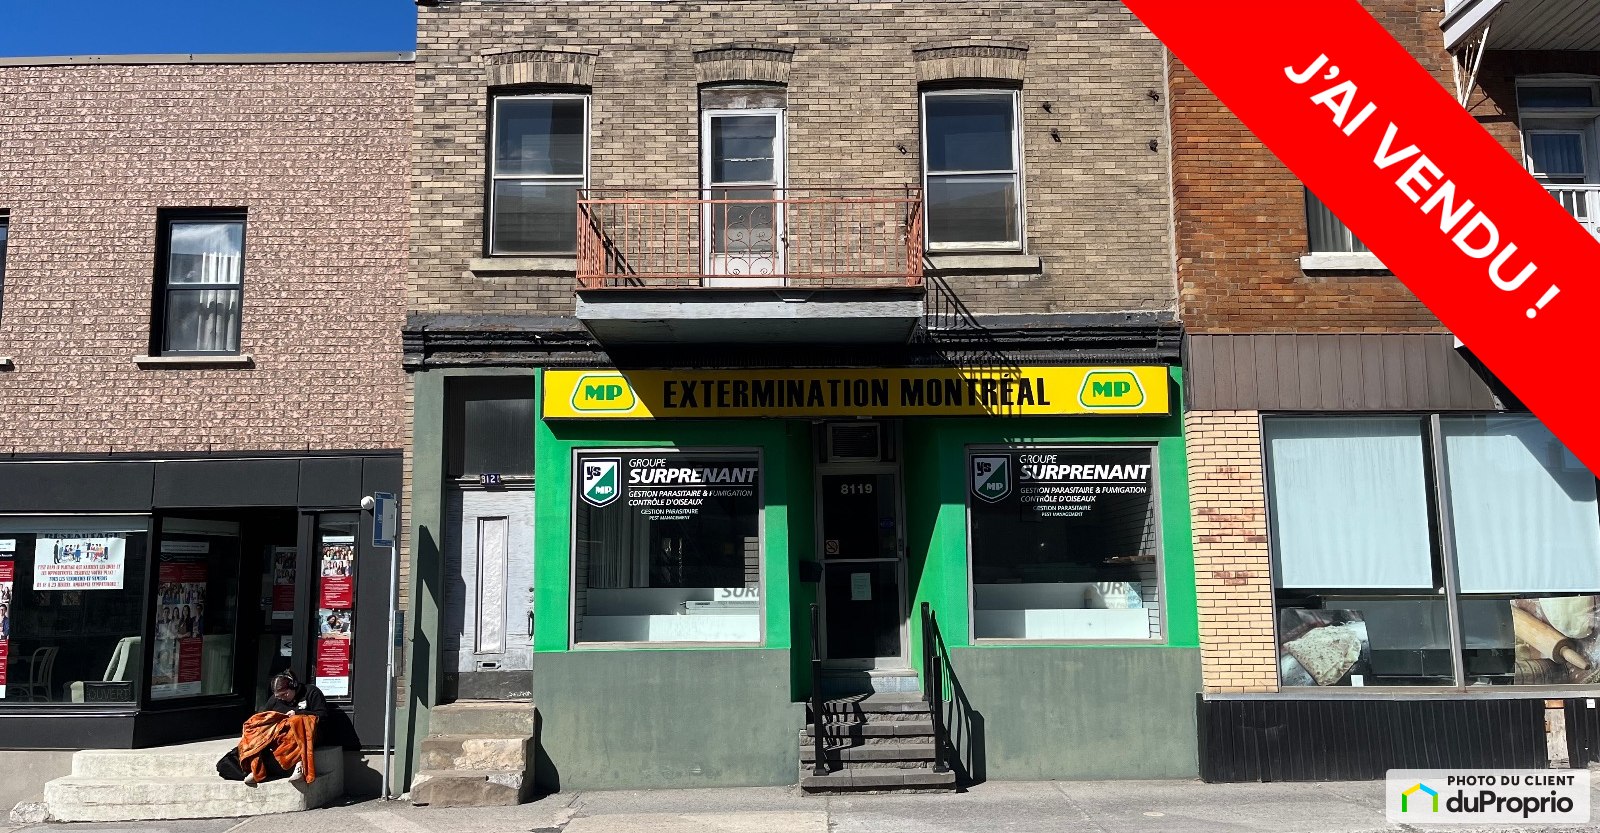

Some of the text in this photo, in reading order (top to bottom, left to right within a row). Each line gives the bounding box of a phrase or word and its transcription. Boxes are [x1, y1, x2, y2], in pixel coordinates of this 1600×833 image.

[585, 385, 623, 401] MP
[663, 373, 1051, 408] EXTERMINATION MONTRÉAL
[1092, 381, 1131, 398] MP
[628, 458, 667, 468] GROUPE
[1019, 454, 1058, 464] GROUPE
[628, 468, 758, 484] SURPRENANT
[1019, 464, 1151, 480] SURPRENANT
[840, 484, 873, 494] 8119
[986, 482, 1004, 491] MP
[1051, 486, 1094, 494] PARASITAIRE
[1095, 486, 1101, 494] &
[1102, 486, 1147, 494] FUMIGATION
[628, 490, 658, 498] GESTION
[702, 489, 708, 497] &
[709, 489, 753, 497] FUMIGATION
[1020, 494, 1097, 503] CONTRÔLE D'OISEAUX
[628, 498, 665, 506] CONTRÔLE
